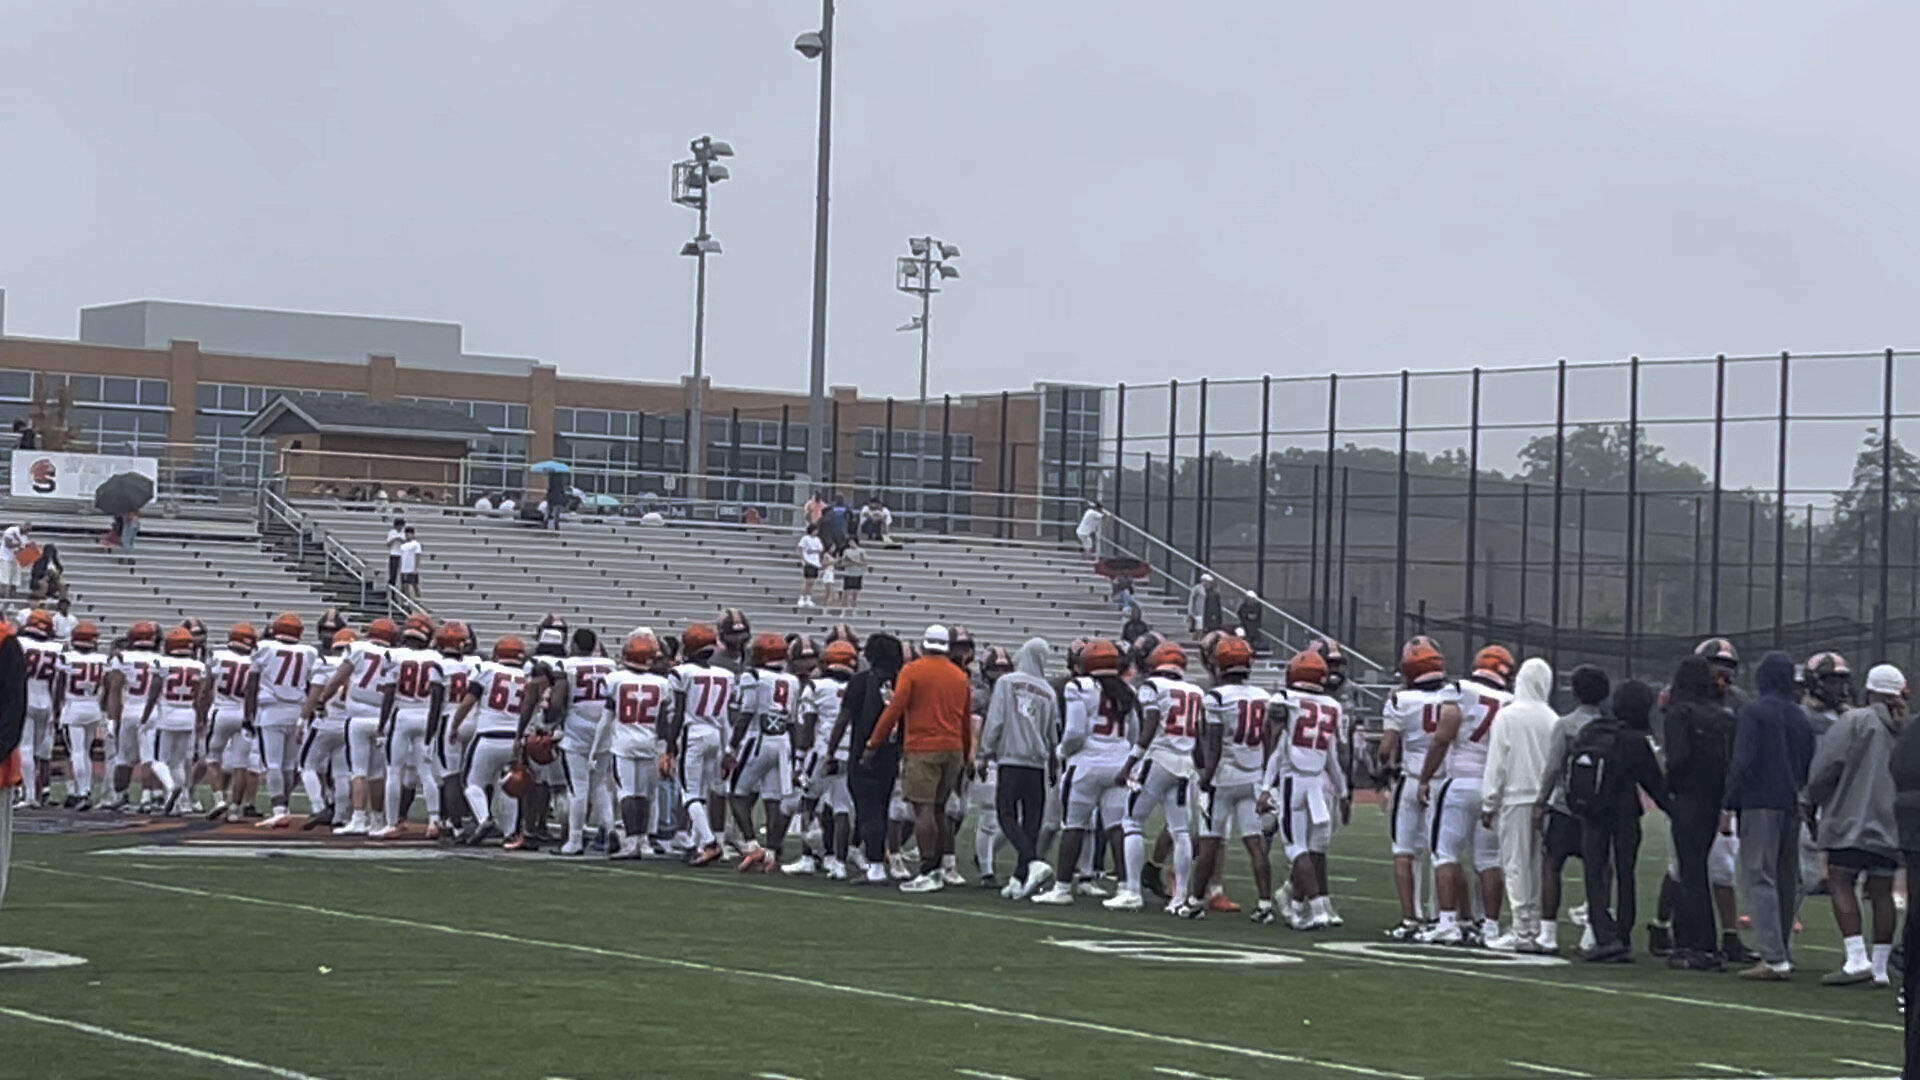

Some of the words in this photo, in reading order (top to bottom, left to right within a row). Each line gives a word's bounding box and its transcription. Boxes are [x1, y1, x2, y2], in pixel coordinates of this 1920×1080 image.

[69, 661, 104, 696] 24
[274, 649, 304, 687] 71
[618, 683, 660, 724] 62
[693, 675, 728, 717] 77
[1233, 698, 1266, 747] 18
